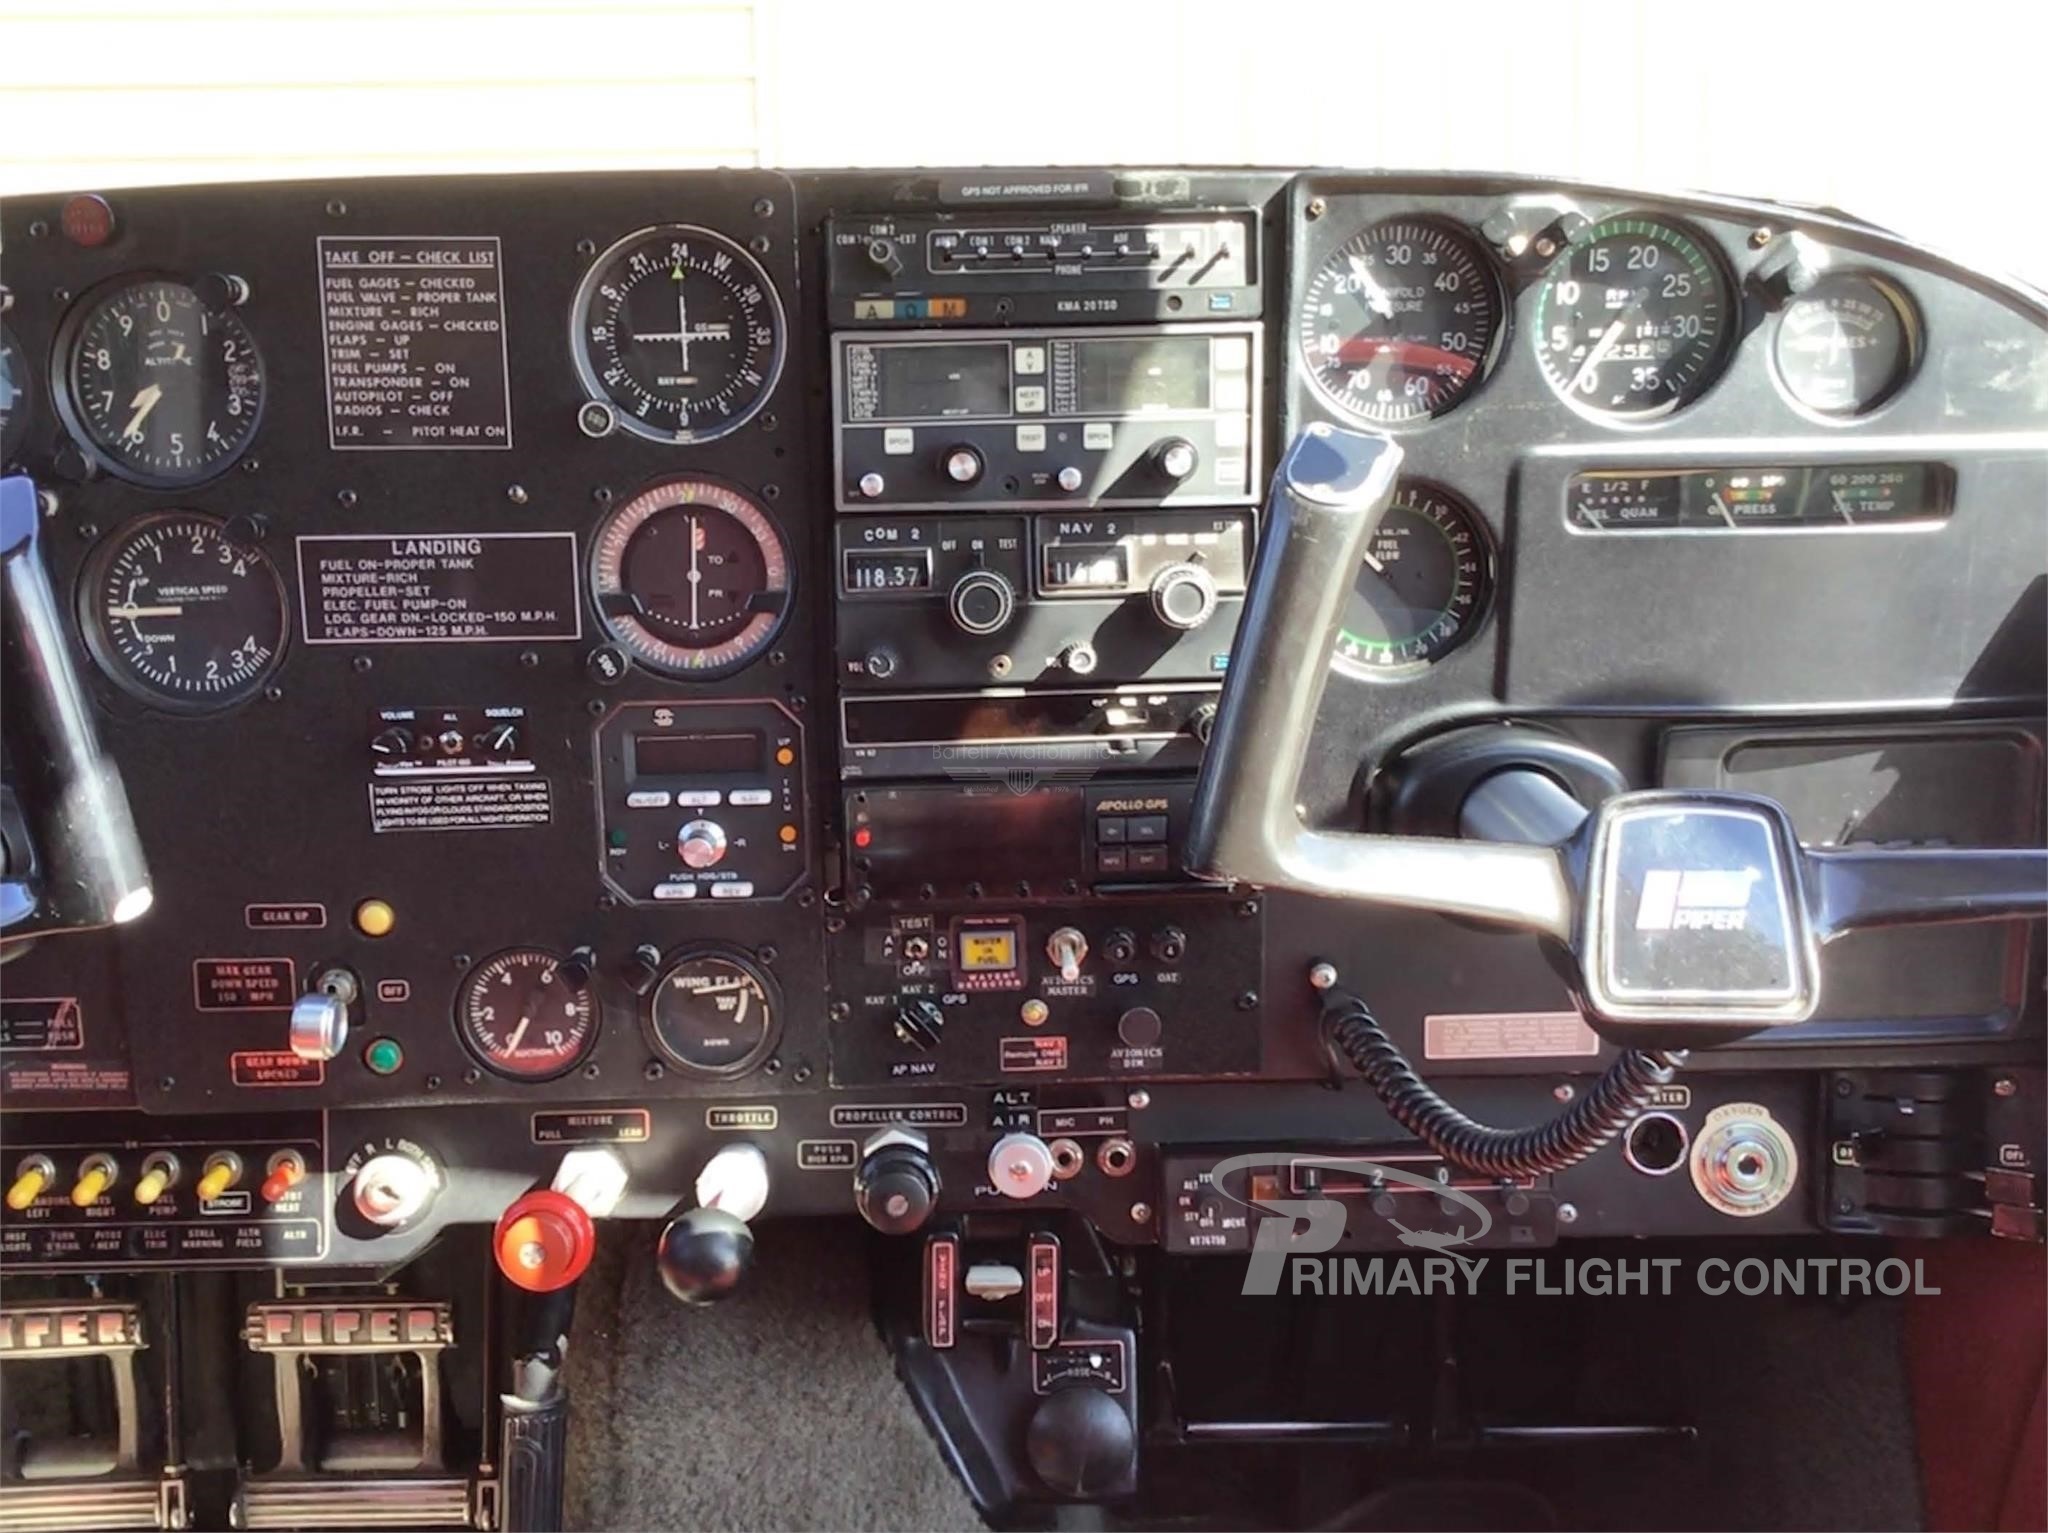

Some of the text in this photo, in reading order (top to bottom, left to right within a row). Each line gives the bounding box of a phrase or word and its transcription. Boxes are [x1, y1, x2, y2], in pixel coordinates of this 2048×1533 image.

[961, 184, 1089, 196] GPS NOT APPROVED FOR IFR
[869, 225, 895, 235] COM 2
[1050, 223, 1088, 234] SPEAKER
[836, 234, 855, 245] COM
[1004, 236, 1030, 246] COM 2
[1113, 233, 1128, 243] ADF
[324, 251, 494, 263] TAKE OFF CHECK LIST
[1385, 245, 1411, 265] 30
[1588, 248, 1611, 273] 15
[1627, 245, 1660, 270] 20
[1054, 266, 1082, 275] PHONE
[325, 278, 475, 289] FUEL GAGES CHECKED
[1434, 272, 1460, 291] 40
[1662, 273, 1692, 298] 25
[326, 292, 497, 303] FUEL VALVE PROPER TANK
[328, 306, 440, 317] MIXTURE RICH
[866, 304, 877, 319] A
[1057, 301, 1080, 311] KMA
[1083, 301, 1096, 311] 20
[329, 320, 499, 331] ENGINE GAGES CHECKED
[1672, 315, 1700, 338] 30
[329, 334, 411, 345] FLAPS UP
[1441, 332, 1466, 351] 50
[331, 349, 410, 359] TRIM SET
[331, 363, 456, 374] FUEL PUMPS ON
[333, 377, 470, 388] TRANSPONDER ON
[334, 391, 453, 402] AUTOPILOT OFF
[334, 405, 450, 416] RADIOS CHECK
[412, 426, 446, 437] PITOT
[450, 426, 480, 437] HEAT
[485, 426, 505, 437] ON
[1603, 481, 1629, 492] 1/2
[1733, 504, 1776, 515] PRESS
[1859, 501, 1895, 512] TEMP
[1620, 507, 1658, 518] QUAN
[1060, 523, 1116, 534] NAV 2
[864, 528, 921, 542] COM 2
[391, 539, 482, 555] LANDING
[942, 540, 956, 551] OFF
[971, 540, 984, 550] ON
[998, 538, 1018, 549] TEST
[1377, 540, 1399, 550] FUEL
[1375, 551, 1400, 560] FLOW
[320, 559, 353, 570] FUEL
[441, 558, 475, 570] TANK
[321, 573, 418, 584] MIXTURE-RICH
[855, 566, 919, 588] 118.37
[157, 585, 228, 596] VERTICAL SPEED
[322, 586, 431, 598] PROPELLER-SET
[364, 600, 398, 611] FUEL
[402, 599, 467, 611] PUMP-ON
[360, 613, 397, 624] GEAR
[325, 625, 447, 637] FLAPS-DOWN-125
[144, 634, 175, 643] DOWN
[1096, 799, 1168, 811] APOLLO GPS
[262, 911, 309, 921] GEAR UP
[1673, 909, 1748, 931] PIPER
[900, 917, 930, 929] TEST
[672, 977, 711, 989] WING
[1113, 973, 1138, 984] GPS
[1047, 986, 1088, 996] MASTER
[942, 994, 968, 1004] GPS
[1110, 1047, 1163, 1058] AVIONICS
[892, 1063, 936, 1075] AP NAV
[1123, 1059, 1144, 1068] DIM
[993, 1092, 1030, 1104] ALT
[713, 1113, 772, 1124] THROTTLE
[836, 1109, 960, 1121] PROPELLER CONTROL
[992, 1113, 1031, 1126] AIR
[1055, 1116, 1114, 1128] MIC PH
[274, 1203, 299, 1213] HEAT
